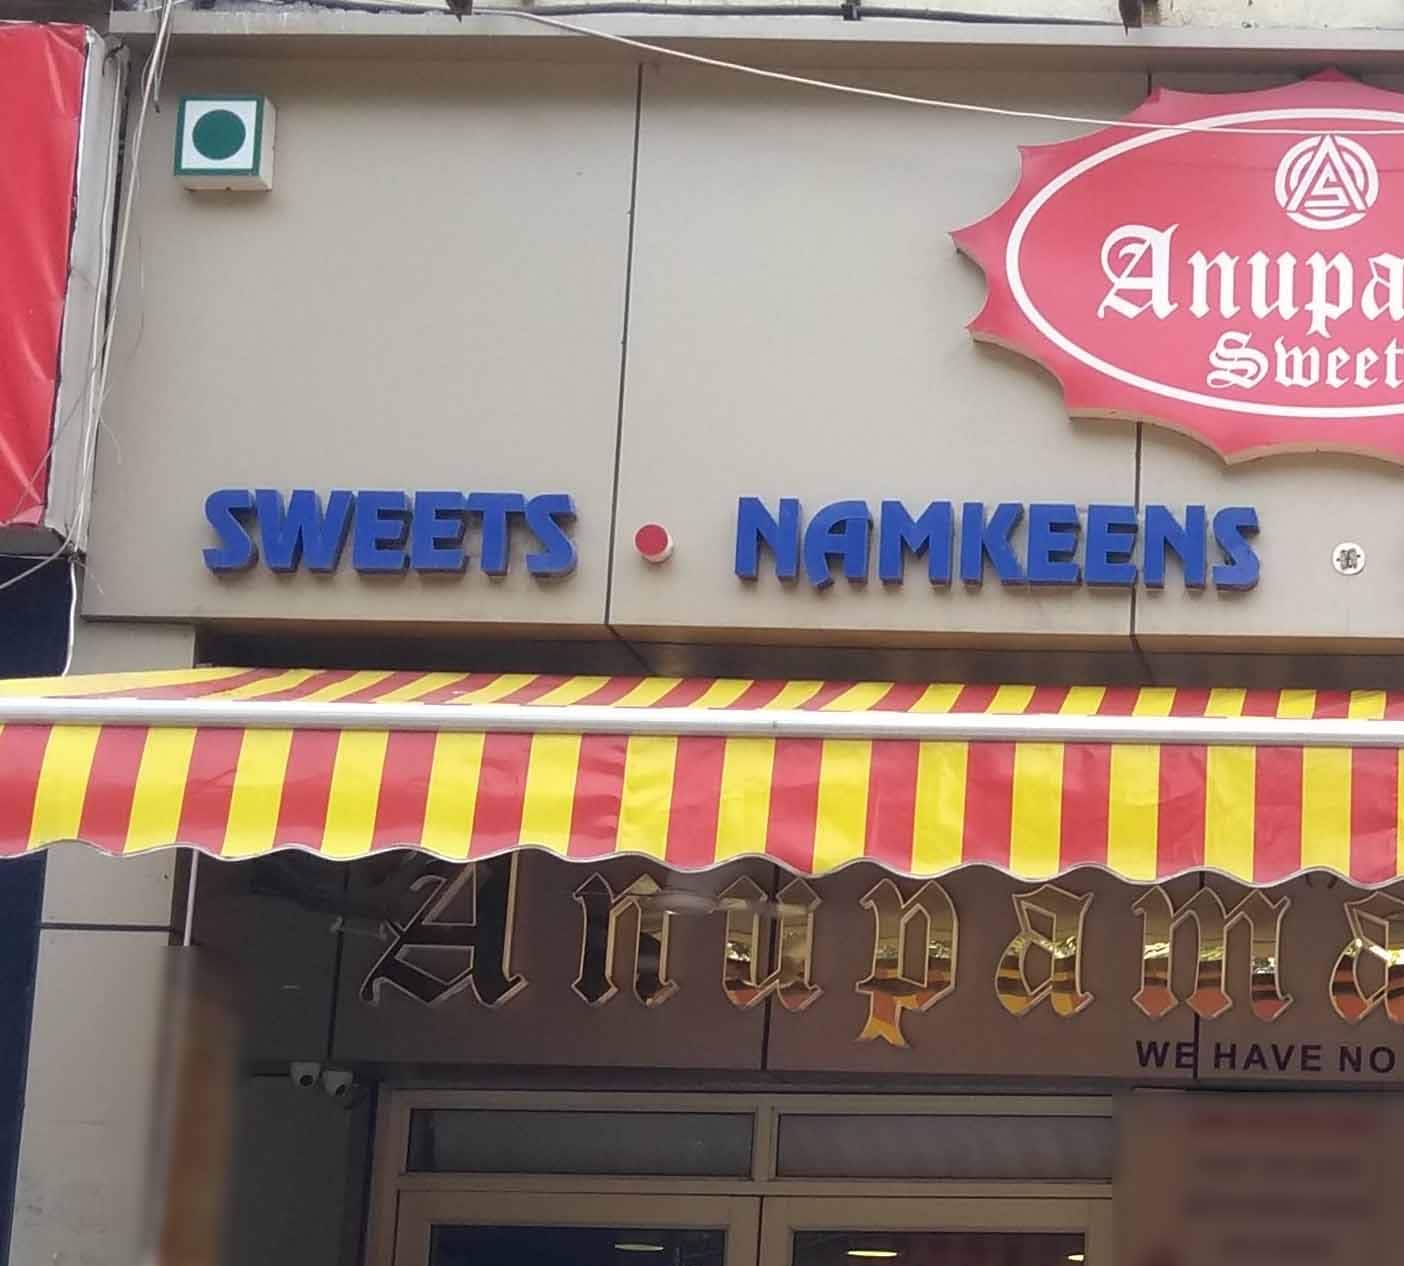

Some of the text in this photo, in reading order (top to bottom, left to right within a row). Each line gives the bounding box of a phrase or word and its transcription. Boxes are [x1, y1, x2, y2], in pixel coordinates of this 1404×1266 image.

[203, 487, 578, 578] SWEETS
[735, 496, 1261, 593] NAMKEENS
[1135, 1040, 1195, 1070] WE
[1213, 1042, 1322, 1073] HAVE
[1339, 1045, 1396, 1074] NO
